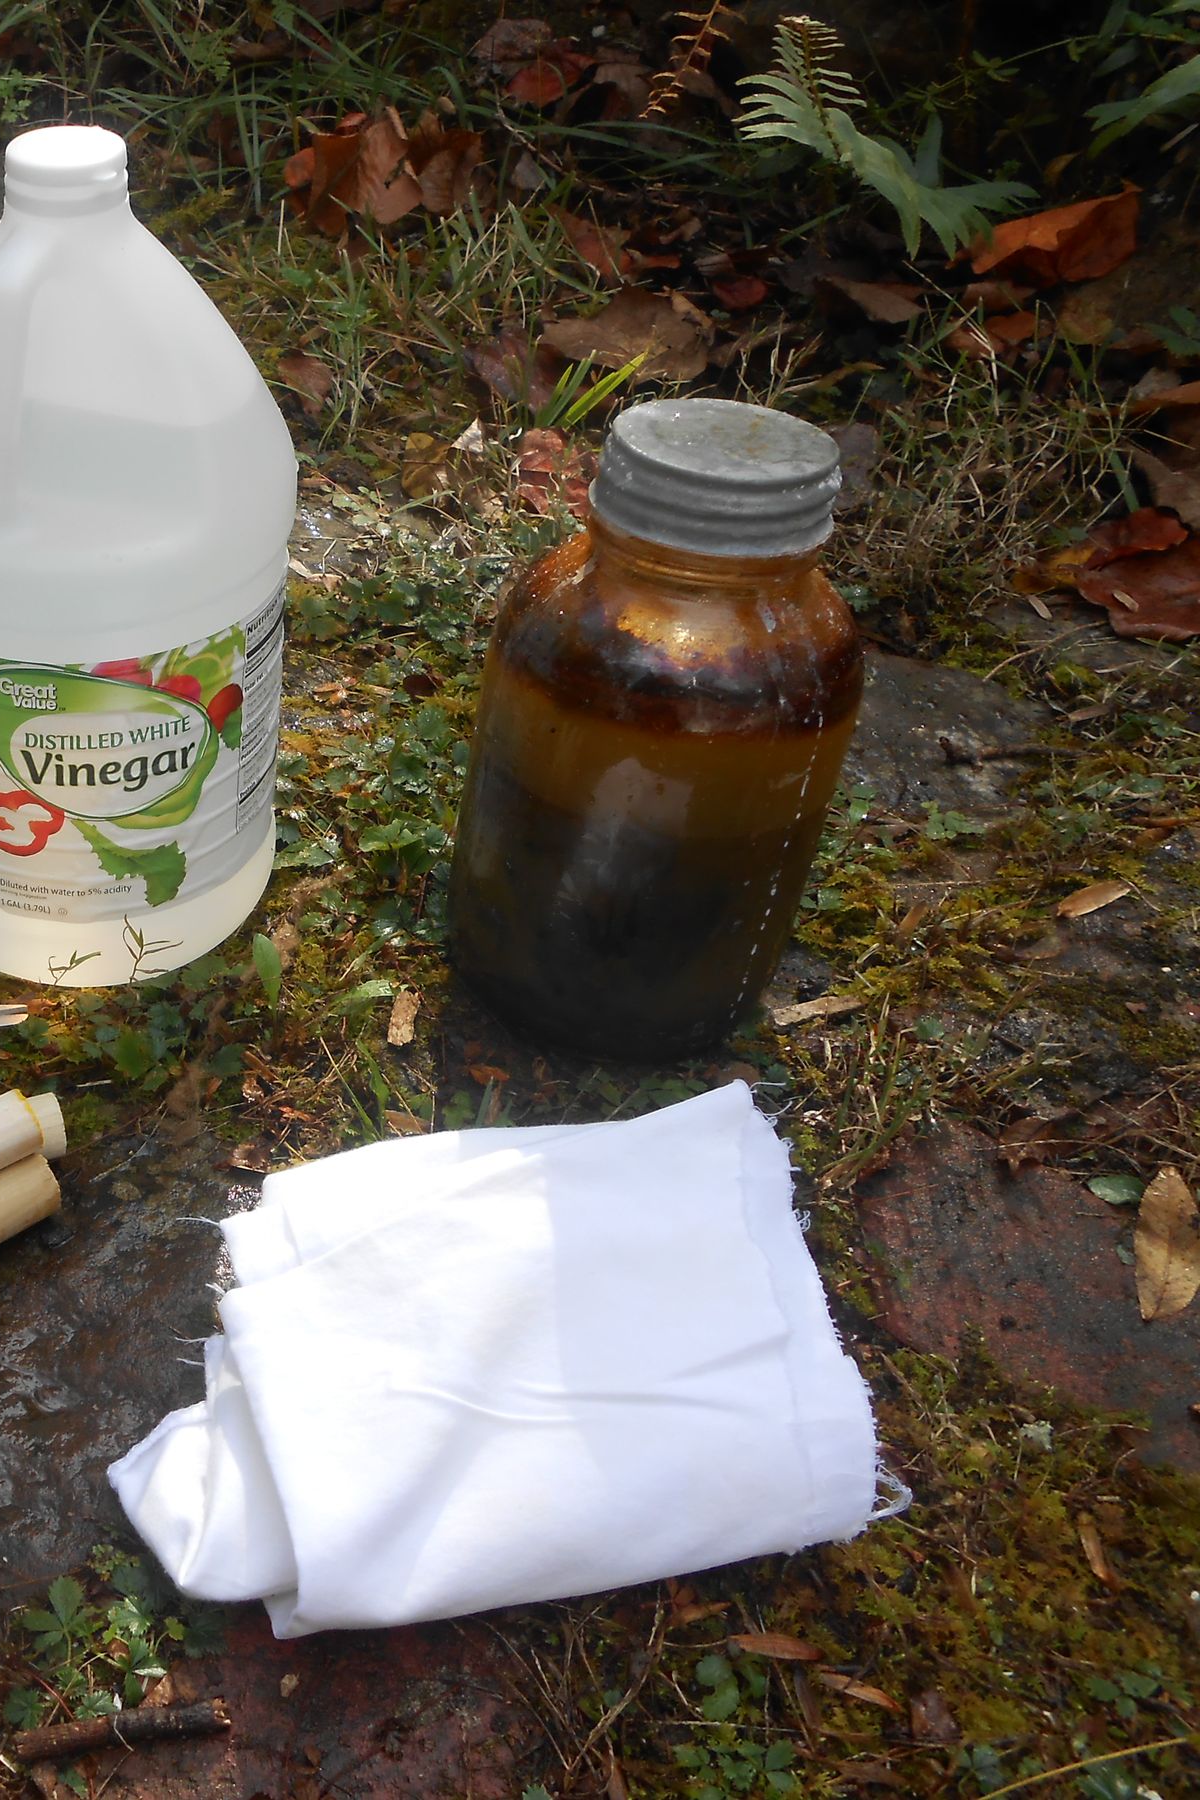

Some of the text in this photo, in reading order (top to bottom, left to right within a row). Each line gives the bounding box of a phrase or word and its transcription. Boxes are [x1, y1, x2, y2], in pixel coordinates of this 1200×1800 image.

[12, 695, 57, 711] Value
[25, 714, 191, 750] DISTILLED WHITE
[19, 742, 196, 792] Vinegar
[0, 878, 28, 892] Diluted
[30, 886, 49, 895] with
[51, 888, 75, 897] water
[88, 888, 102, 896] 5%
[104, 885, 132, 895] acidity
[7, 900, 20, 909] GAL
[23, 903, 51, 914] (3.79L)
